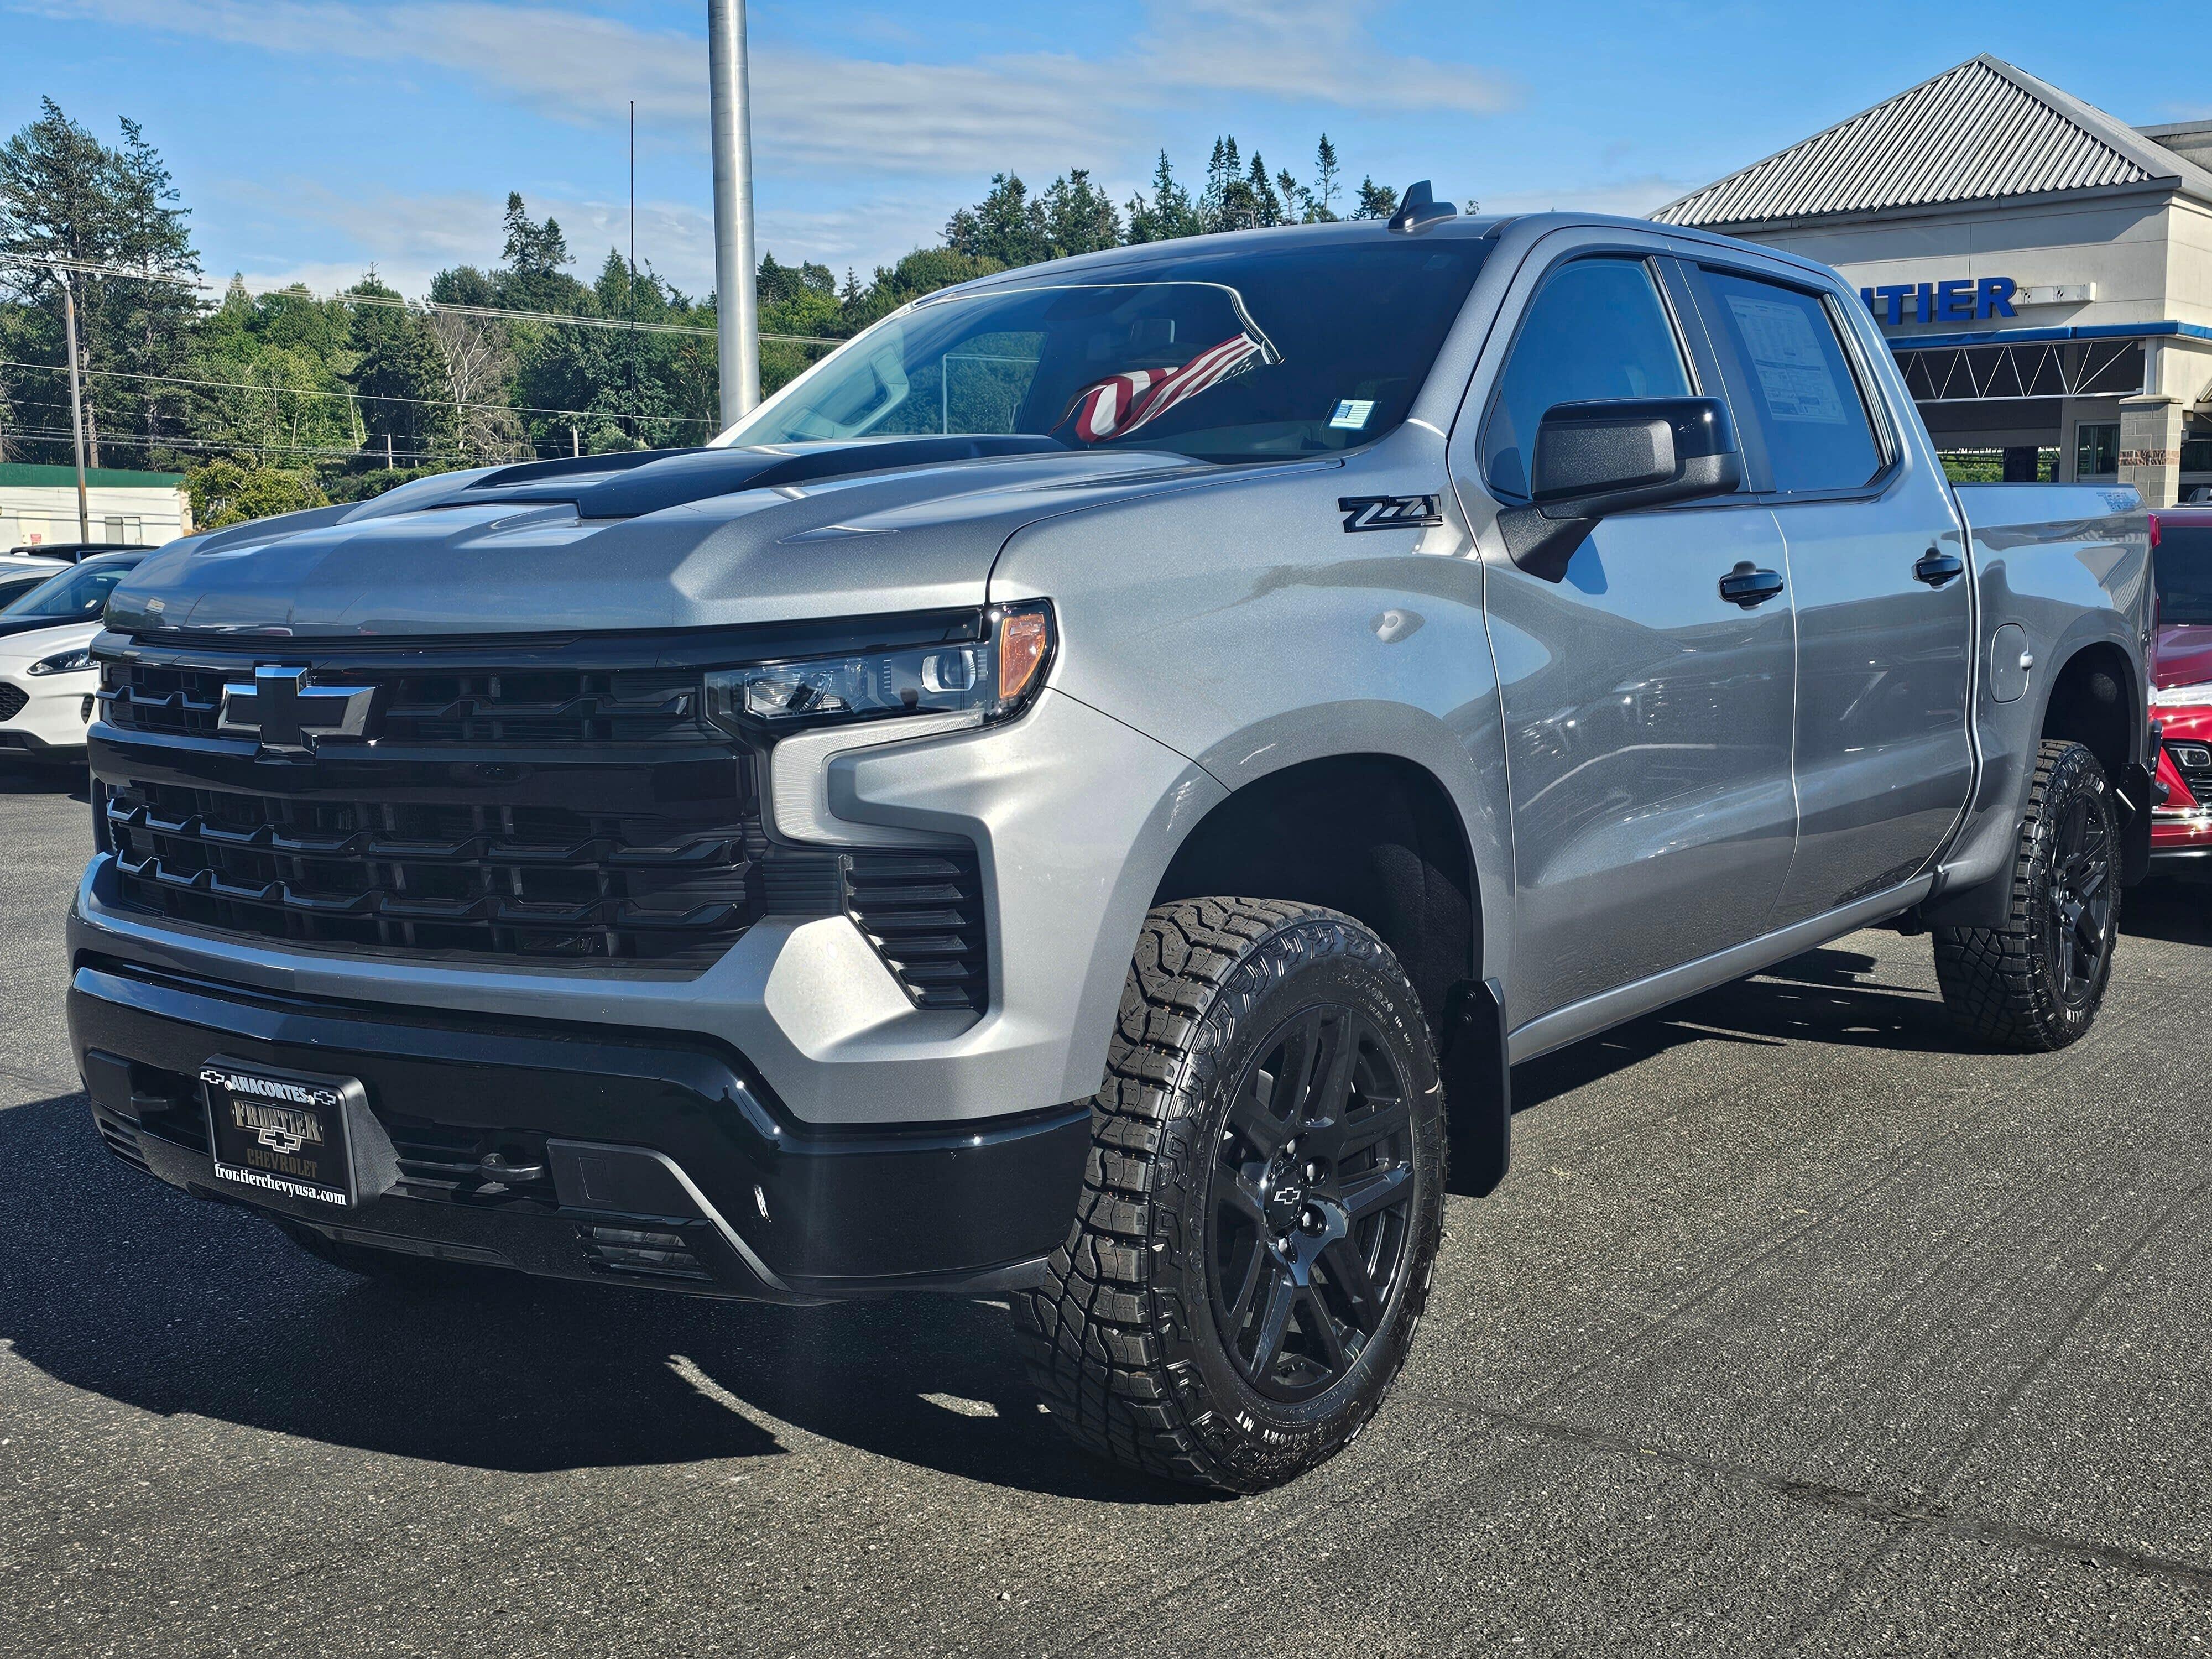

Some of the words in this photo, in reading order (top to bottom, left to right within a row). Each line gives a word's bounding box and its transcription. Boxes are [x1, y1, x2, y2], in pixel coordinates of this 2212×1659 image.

[1860, 276, 2018, 325] TIER
[1338, 494, 1443, 533] Z71
[231, 1074, 309, 1103] ANACORTES
[233, 1099, 321, 1142] FRONTIER
[247, 1148, 317, 1178] CHEVROLET
[215, 1164, 347, 1206] frontierchevyusa.com
[1234, 1410, 1255, 1433] MT
